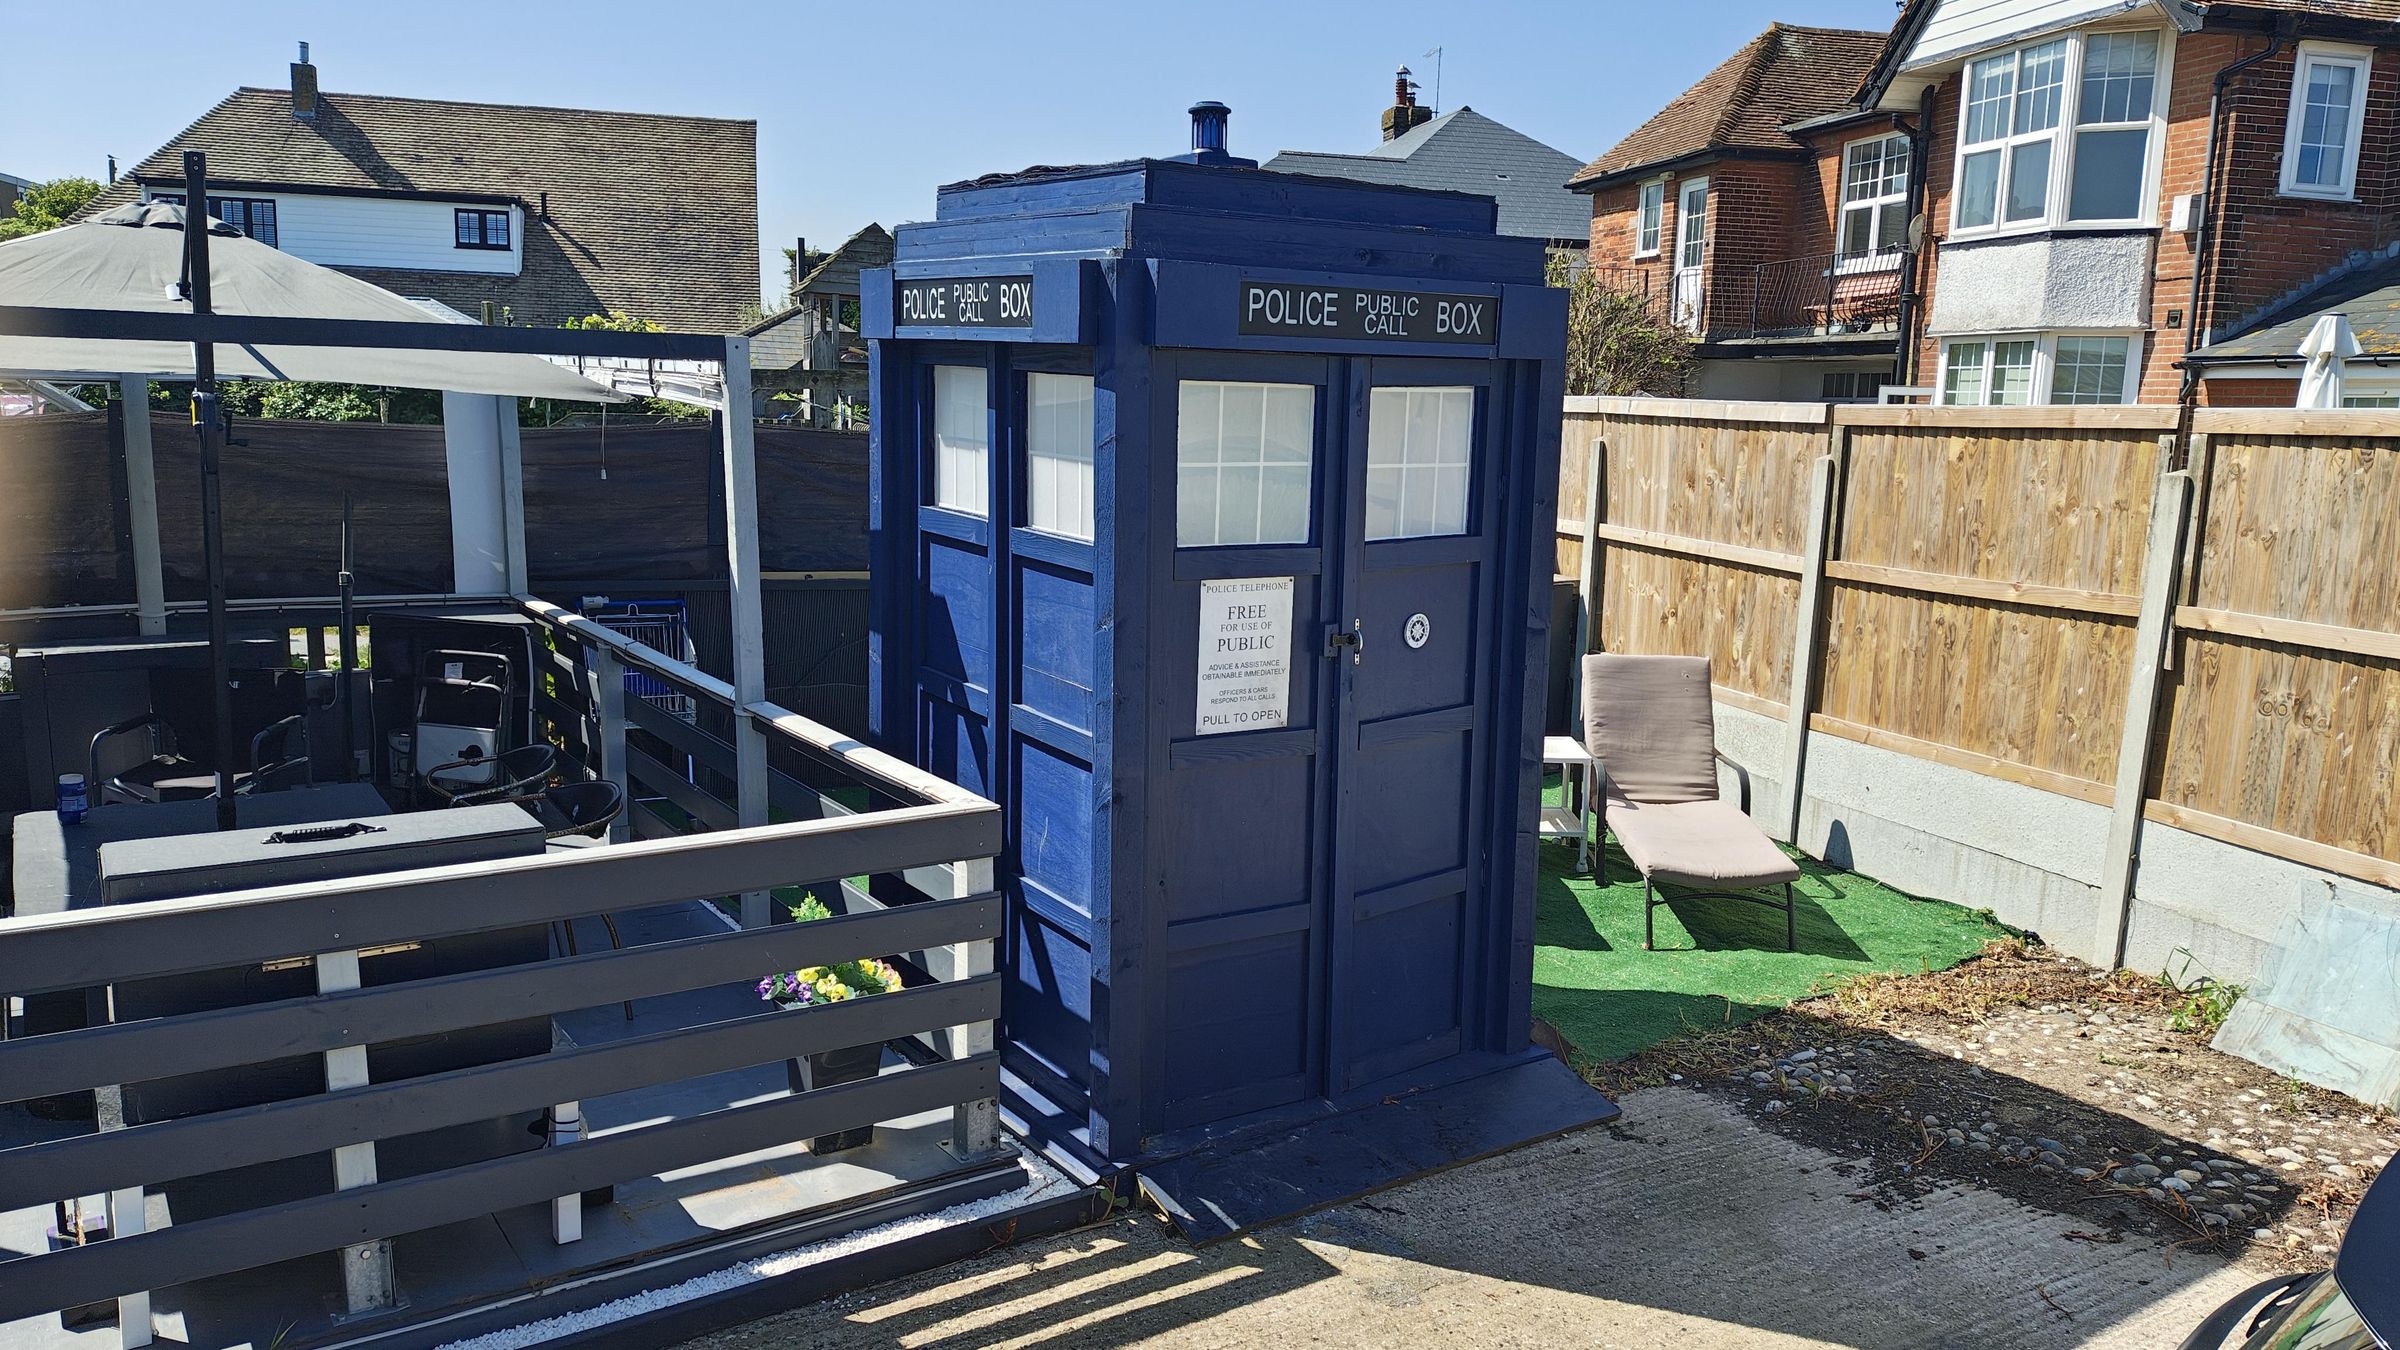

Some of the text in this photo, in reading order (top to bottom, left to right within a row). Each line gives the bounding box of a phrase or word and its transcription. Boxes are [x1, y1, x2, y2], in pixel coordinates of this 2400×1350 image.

[904, 282, 1031, 319] POLICE PUBLIC BOX
[959, 303, 984, 322] CALL
[1249, 288, 1483, 335] POLICE PUBLIC BOX
[1364, 315, 1408, 335] CALL
[1206, 582, 1288, 593] POLICE TELEPHONE
[1228, 605, 1266, 620] FREE
[1221, 622, 1272, 632] FOR USE OF
[1218, 635, 1275, 652] PUBLIC
[1209, 663, 1234, 671] ADVICE
[1240, 660, 1280, 669] ASSISTANCE
[1202, 668, 1286, 680] OBTAINABLE IMMEDIATELY
[1211, 697, 1238, 705] RESPOND
[1203, 710, 1282, 726] PULL TO OPEN
